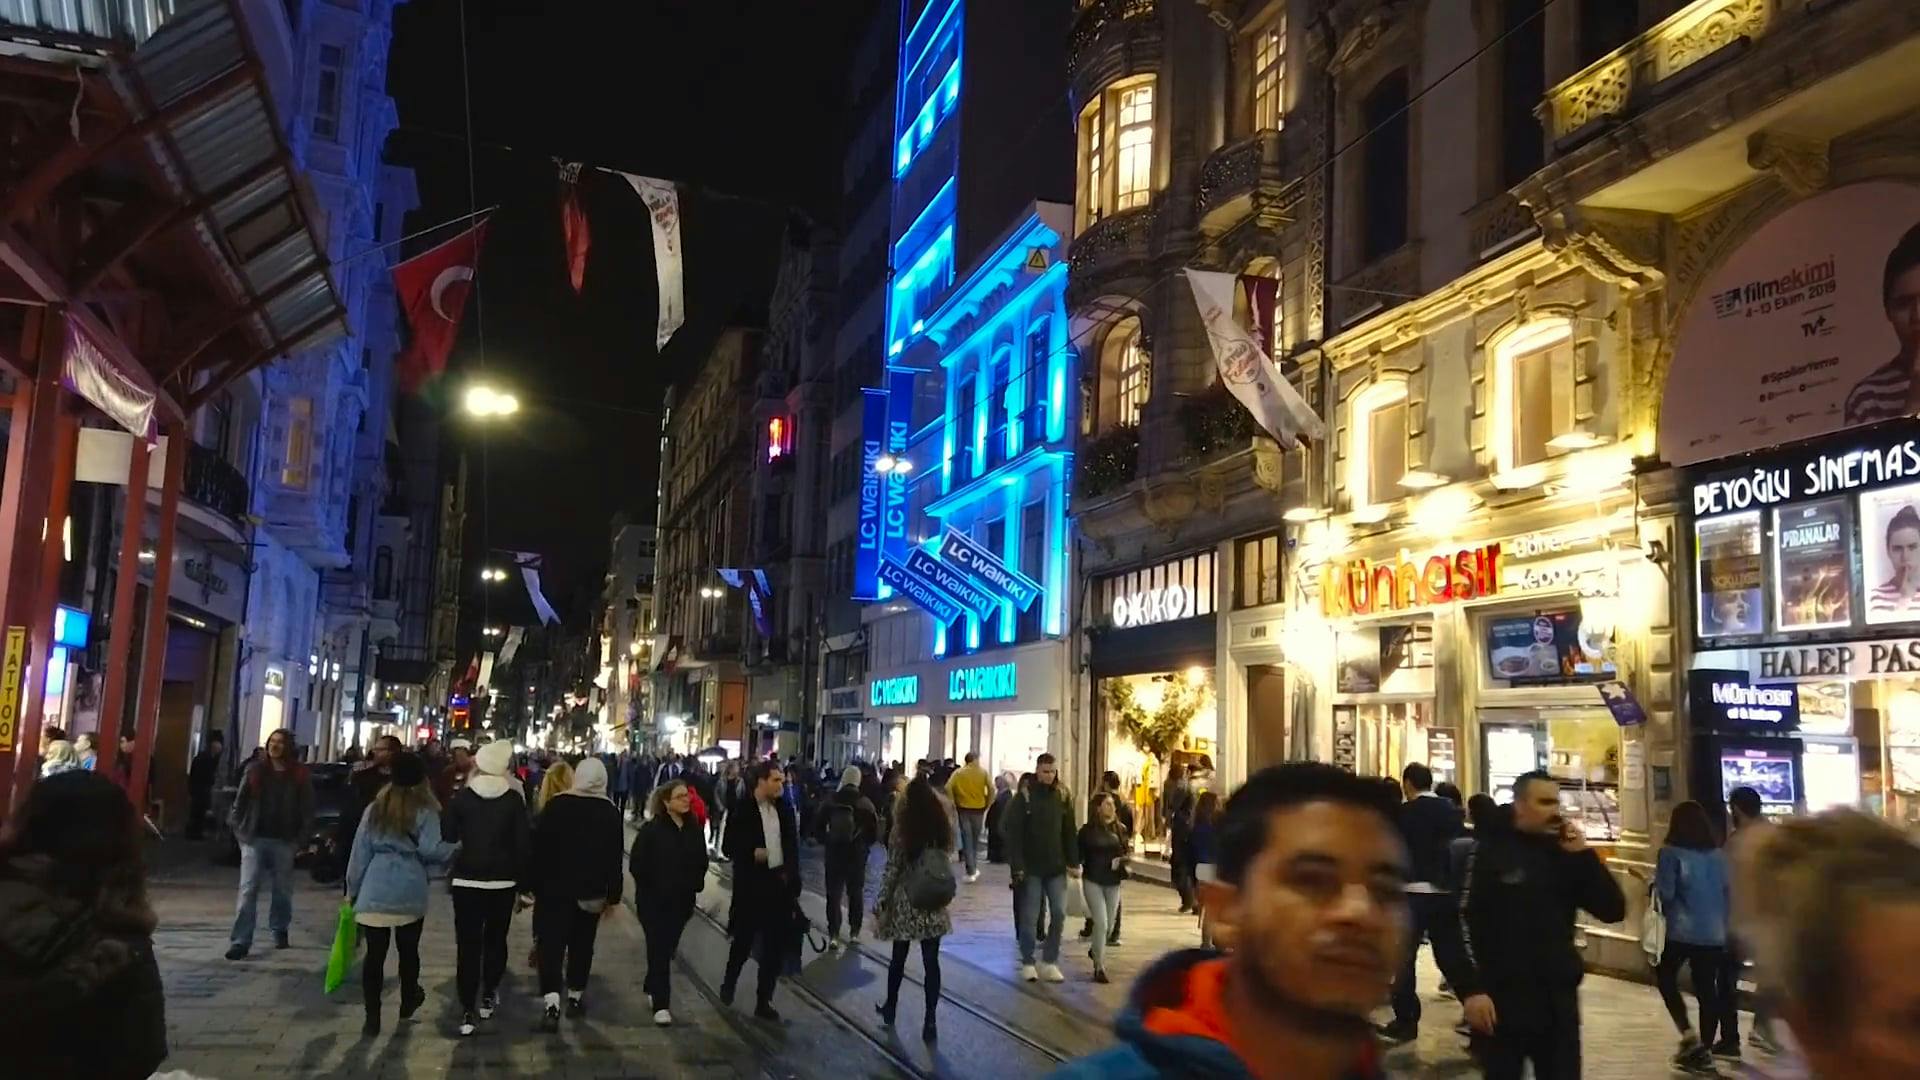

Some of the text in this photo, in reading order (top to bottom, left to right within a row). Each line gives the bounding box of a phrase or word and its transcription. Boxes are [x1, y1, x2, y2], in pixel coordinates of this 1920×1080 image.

[1744, 254, 1835, 304] filmekimi
[1808, 280, 1836, 299] 2019
[1693, 468, 1791, 516] BEYOĞLU
[860, 522, 877, 550] LC
[886, 509, 905, 538] LC
[914, 556, 936, 575] LC
[949, 541, 971, 562] LC
[884, 565, 904, 583] LC
[1759, 646, 1855, 679] HALEP
[0, 635, 20, 738] TATTOO
[949, 668, 965, 701] LC
